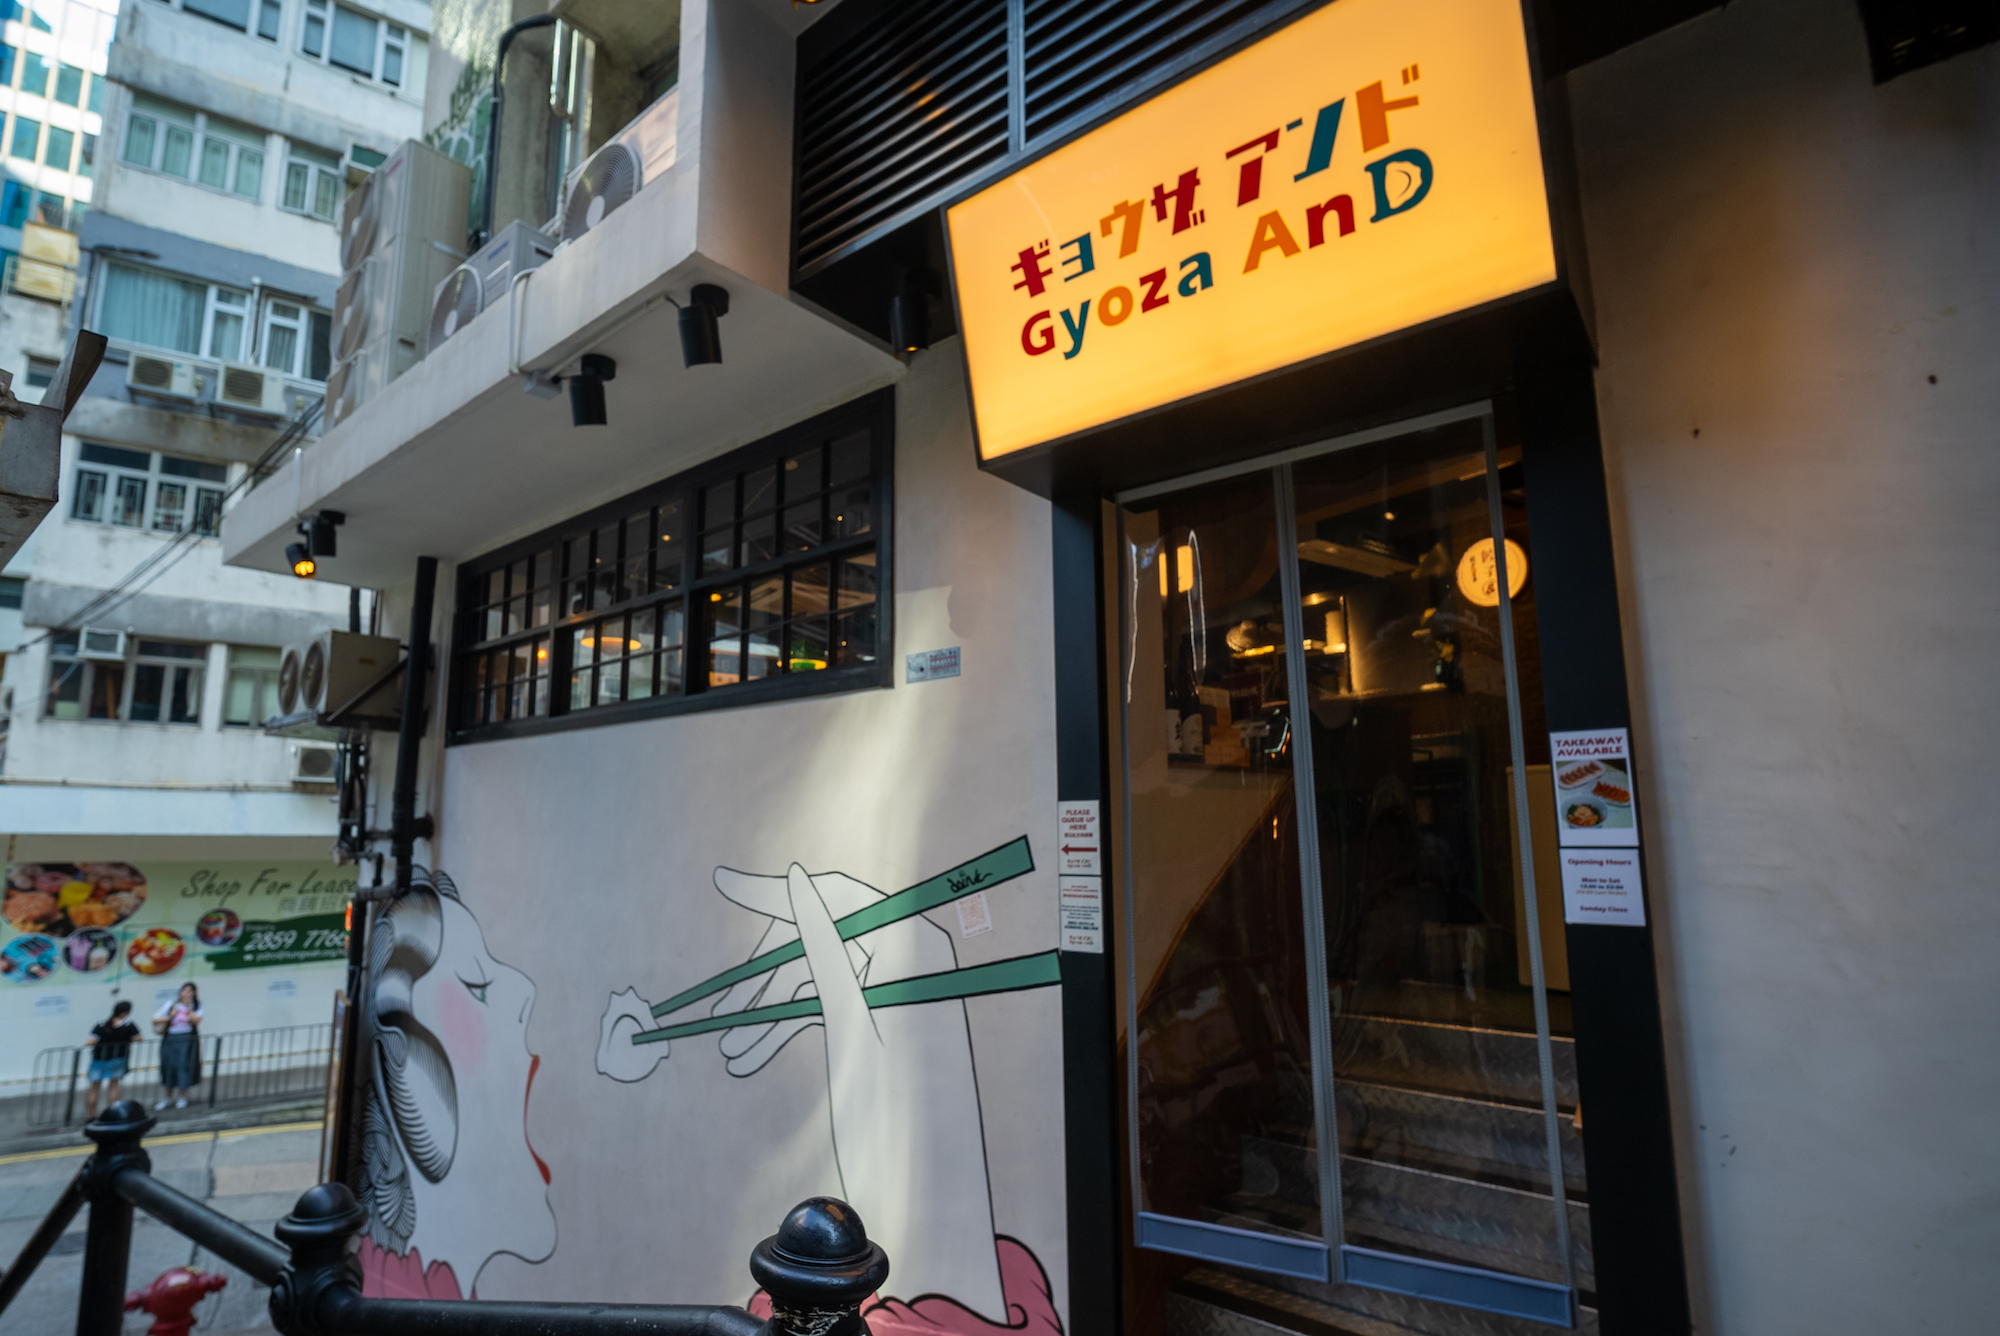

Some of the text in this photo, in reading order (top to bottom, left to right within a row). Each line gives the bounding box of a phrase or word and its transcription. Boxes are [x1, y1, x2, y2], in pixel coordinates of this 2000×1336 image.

[1010, 63, 1421, 298] ギョウザ アンド
[1020, 250, 1214, 360] Gyoza
[1556, 736, 1622, 748] TAKEAWAY
[1557, 746, 1622, 757] AVAILABLE
[1568, 858, 1604, 867] Opening
[181, 868, 356, 908] Shop For Lease
[1580, 905, 1606, 914] Sunday
[243, 929, 298, 951] 2859
